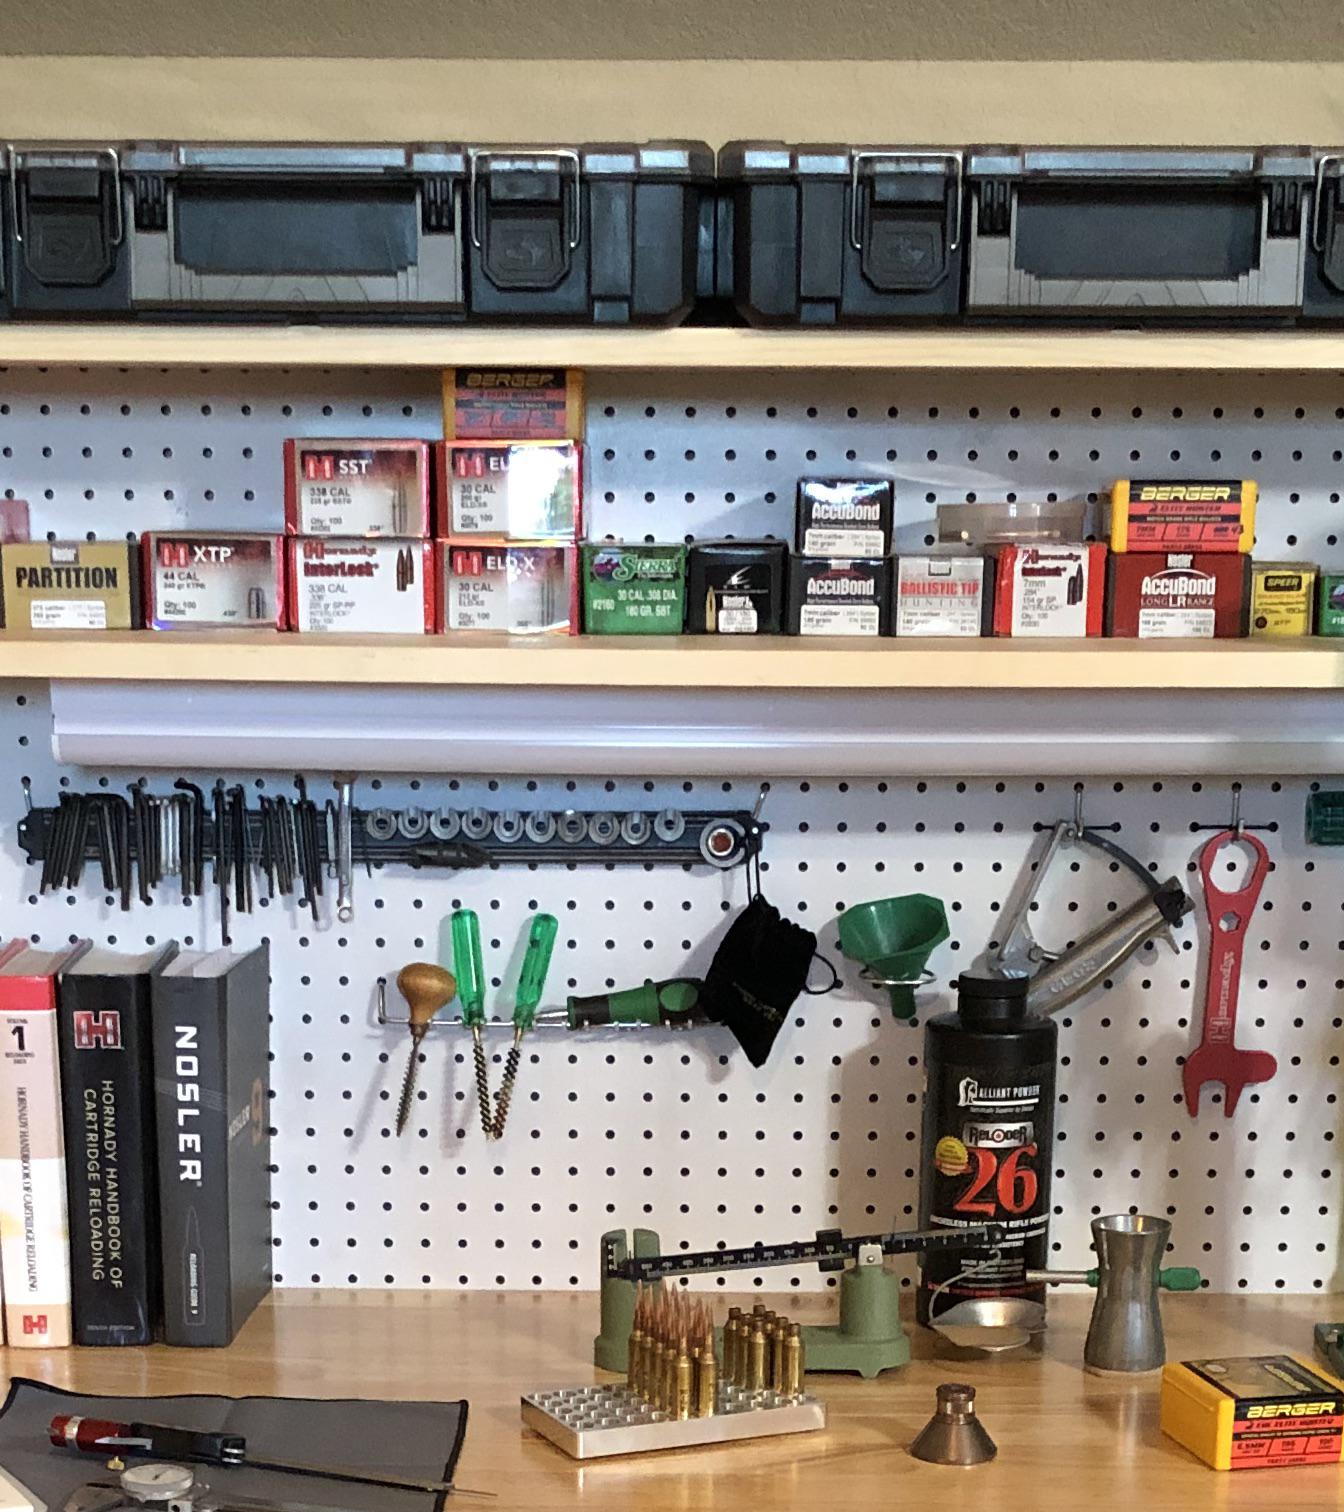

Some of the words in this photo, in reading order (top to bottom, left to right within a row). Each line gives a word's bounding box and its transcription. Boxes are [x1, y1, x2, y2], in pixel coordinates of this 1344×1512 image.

[339, 459, 368, 475] SST
[330, 487, 351, 497] CAL
[461, 484, 472, 494] 30
[475, 484, 496, 494] CAL
[1140, 486, 1231, 501] BERGER
[811, 501, 881, 521] AccuBond
[193, 545, 233, 563] XTP
[15, 566, 118, 589] PARTITION
[163, 571, 175, 580] 44
[178, 571, 200, 581] CAL
[1023, 579, 1046, 588] 7mm
[1266, 577, 1301, 588] SPEER
[327, 583, 348, 594] CAL
[458, 582, 470, 592] 30
[472, 582, 494, 592] CAL
[806, 577, 875, 595] AccuBond
[900, 581, 958, 596] BALLISTIC
[961, 579, 980, 596] TIP
[1141, 575, 1216, 595] AccuBond
[617, 589, 627, 601] 30
[899, 597, 979, 608] HUNTING
[1140, 597, 1169, 607] LONG
[1169, 595, 1186, 607] LR
[11, 1025, 26, 1051] 1
[978, 1087, 1012, 1099] ALLIANT
[1012, 1085, 1041, 1098] POWDER
[174, 1025, 202, 1182] NOSLER
[101, 1079, 118, 1162] HORNADY
[83, 1088, 102, 1181] CARTRIDGE
[953, 1142, 1038, 1217] 26
[105, 1167, 123, 1261] HANDBOOK
[88, 1187, 105, 1282] RELOADING
[109, 1266, 124, 1289] OF
[1246, 1401, 1336, 1419] BERGER
